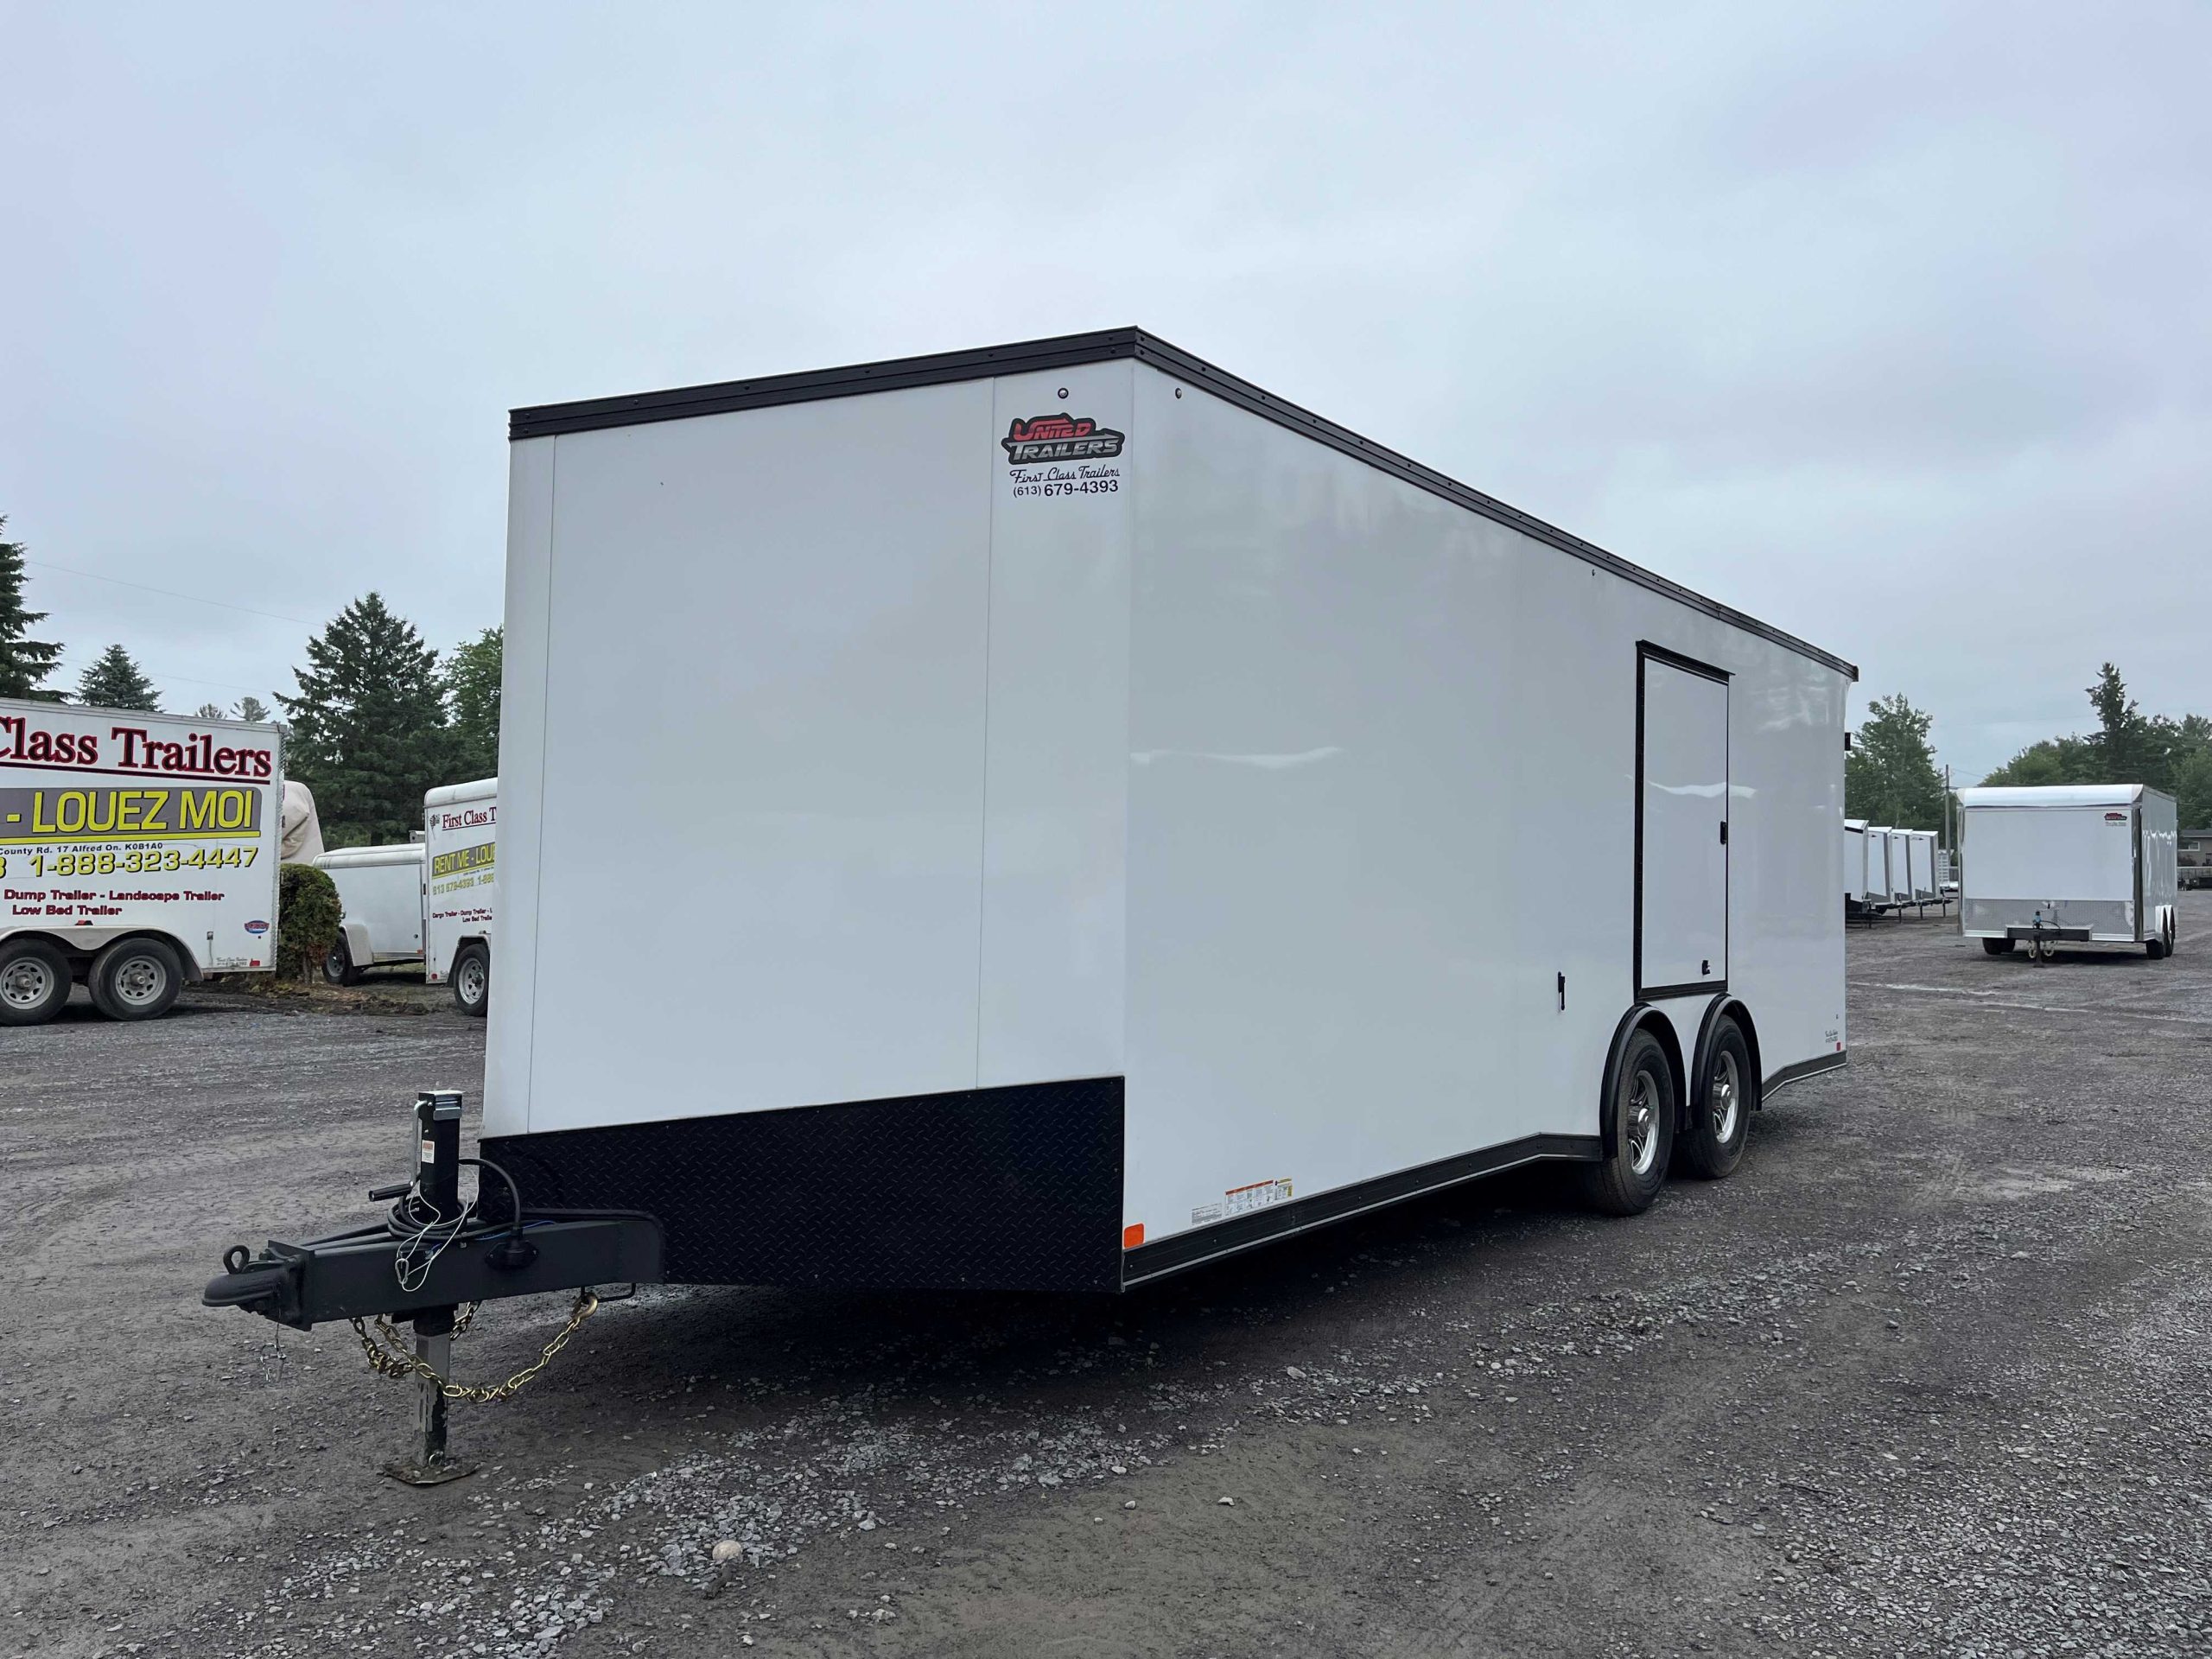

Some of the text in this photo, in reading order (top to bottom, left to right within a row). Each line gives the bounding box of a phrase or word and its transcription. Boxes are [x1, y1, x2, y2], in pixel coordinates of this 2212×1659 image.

[1007, 434, 1121, 461] TRAILERS
[1043, 467, 1077, 481] Class
[1078, 464, 1120, 479] Trailers
[1013, 480, 1119, 498] (613) 679-4393
[111, 727, 272, 778] Trailers
[31, 791, 169, 834] LOUEZ
[179, 790, 254, 830] MOI
[442, 814, 462, 829] First
[464, 810, 487, 825] Class
[72, 844, 102, 853] Alfred
[29, 847, 258, 878] 1-888-323-4447
[434, 854, 455, 874] RENT
[457, 850, 469, 868] ME
[4, 889, 47, 902] Dump
[50, 890, 97, 900] Trailer
[109, 890, 180, 903] Landscape
[183, 891, 225, 900] Trailer
[12, 905, 123, 915] Low Bed Trailer
